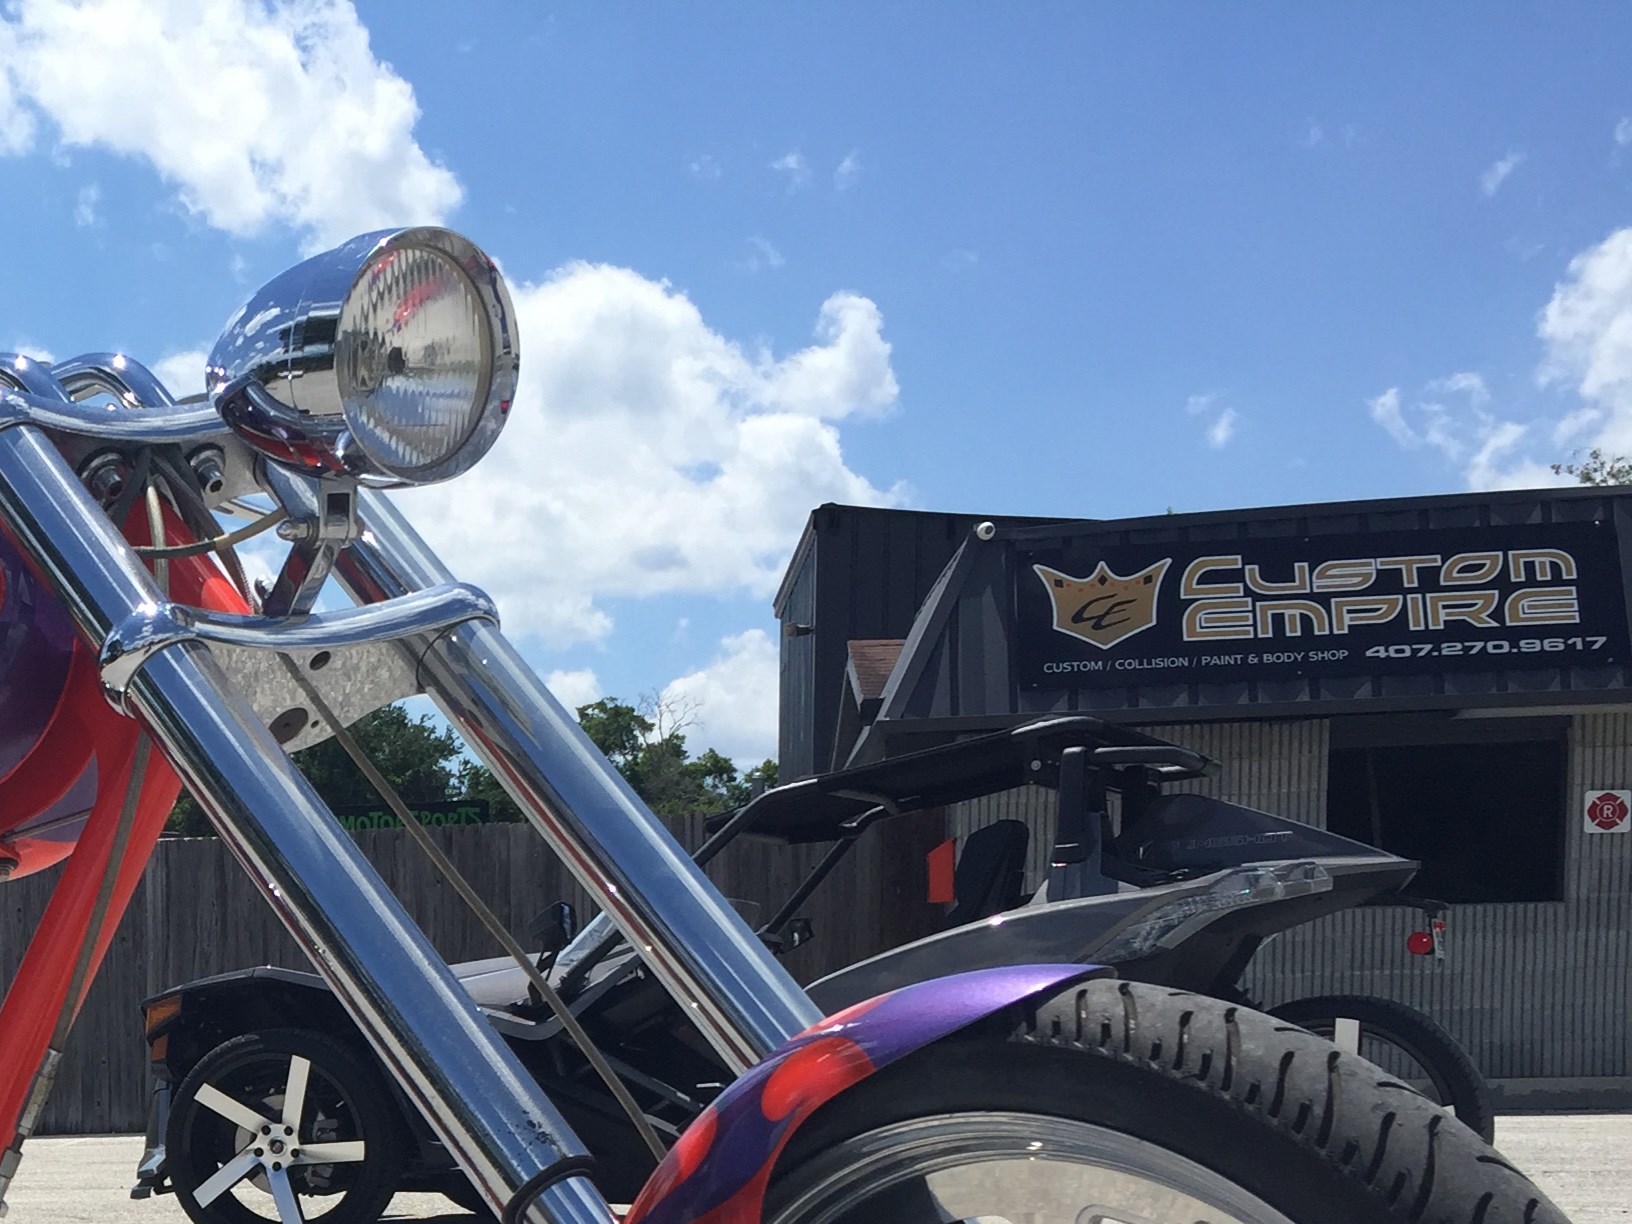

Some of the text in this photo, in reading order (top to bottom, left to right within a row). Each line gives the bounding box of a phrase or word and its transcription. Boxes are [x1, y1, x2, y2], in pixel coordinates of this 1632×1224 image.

[1180, 548, 1578, 599] CUSTOM
[1070, 593, 1138, 631] CE
[1181, 586, 1581, 642] EMPIRE
[1364, 636, 1608, 660] 407.270.9617
[1043, 660, 1104, 673] CUSTOM
[1114, 656, 1189, 670] COLLISION
[1201, 654, 1244, 667] PAINT
[1247, 653, 1259, 665] &
[1262, 651, 1306, 664] BODY
[1308, 649, 1350, 662] SHOP
[338, 807, 483, 832] MOTORPORTS
[1602, 804, 1614, 818] R
